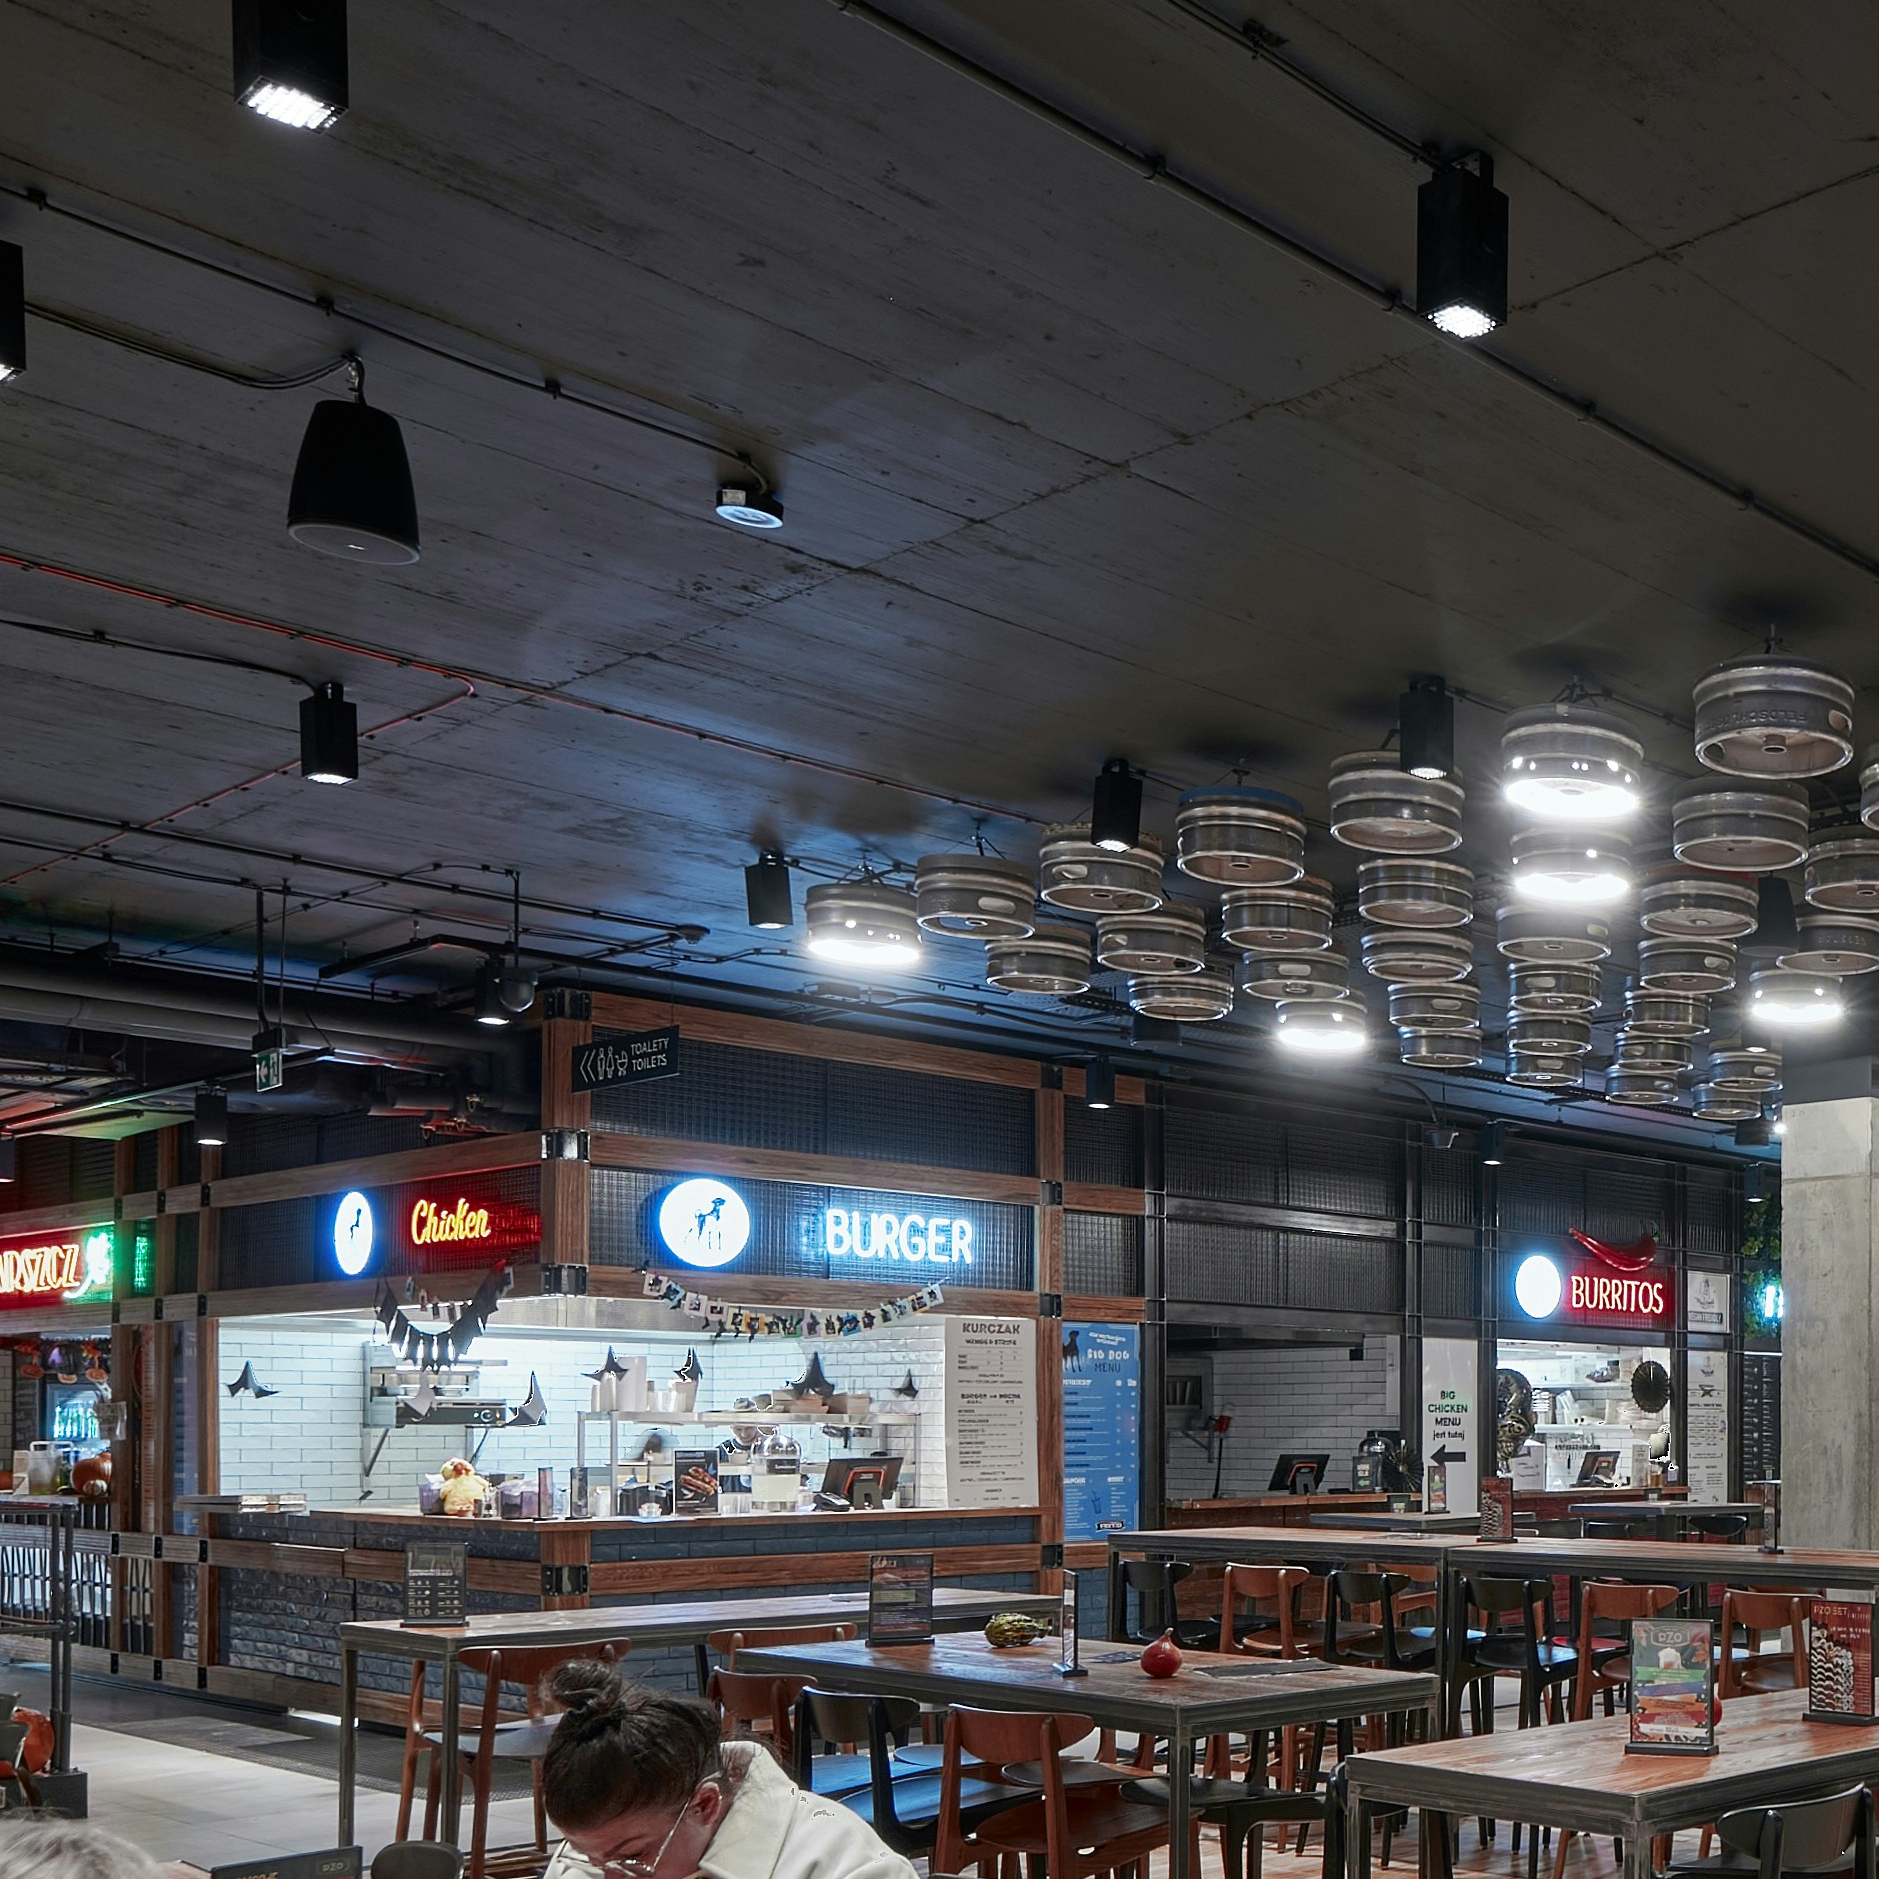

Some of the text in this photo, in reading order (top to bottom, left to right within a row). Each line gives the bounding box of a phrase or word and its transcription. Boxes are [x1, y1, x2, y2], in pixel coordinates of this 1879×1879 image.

[630, 1037, 669, 1056] TOALETY
[631, 1054, 667, 1072] TOILETS
[411, 1197, 491, 1245] Chicken
[826, 1208, 973, 1264] BURGER
[1571, 1275, 1664, 1315] BURRITOS
[962, 1322, 1020, 1335] KURCZAK
[1108, 1350, 1130, 1360] DOG
[1094, 1362, 1121, 1374] MENU
[1440, 1390, 1456, 1400] BIG
[1427, 1403, 1468, 1413] CHICKEN
[1435, 1416, 1462, 1427] MENU
[1432, 1430, 1465, 1442] jest tutaj
[1813, 1605, 1831, 1616] PZO
[1832, 1606, 1848, 1617] SET
